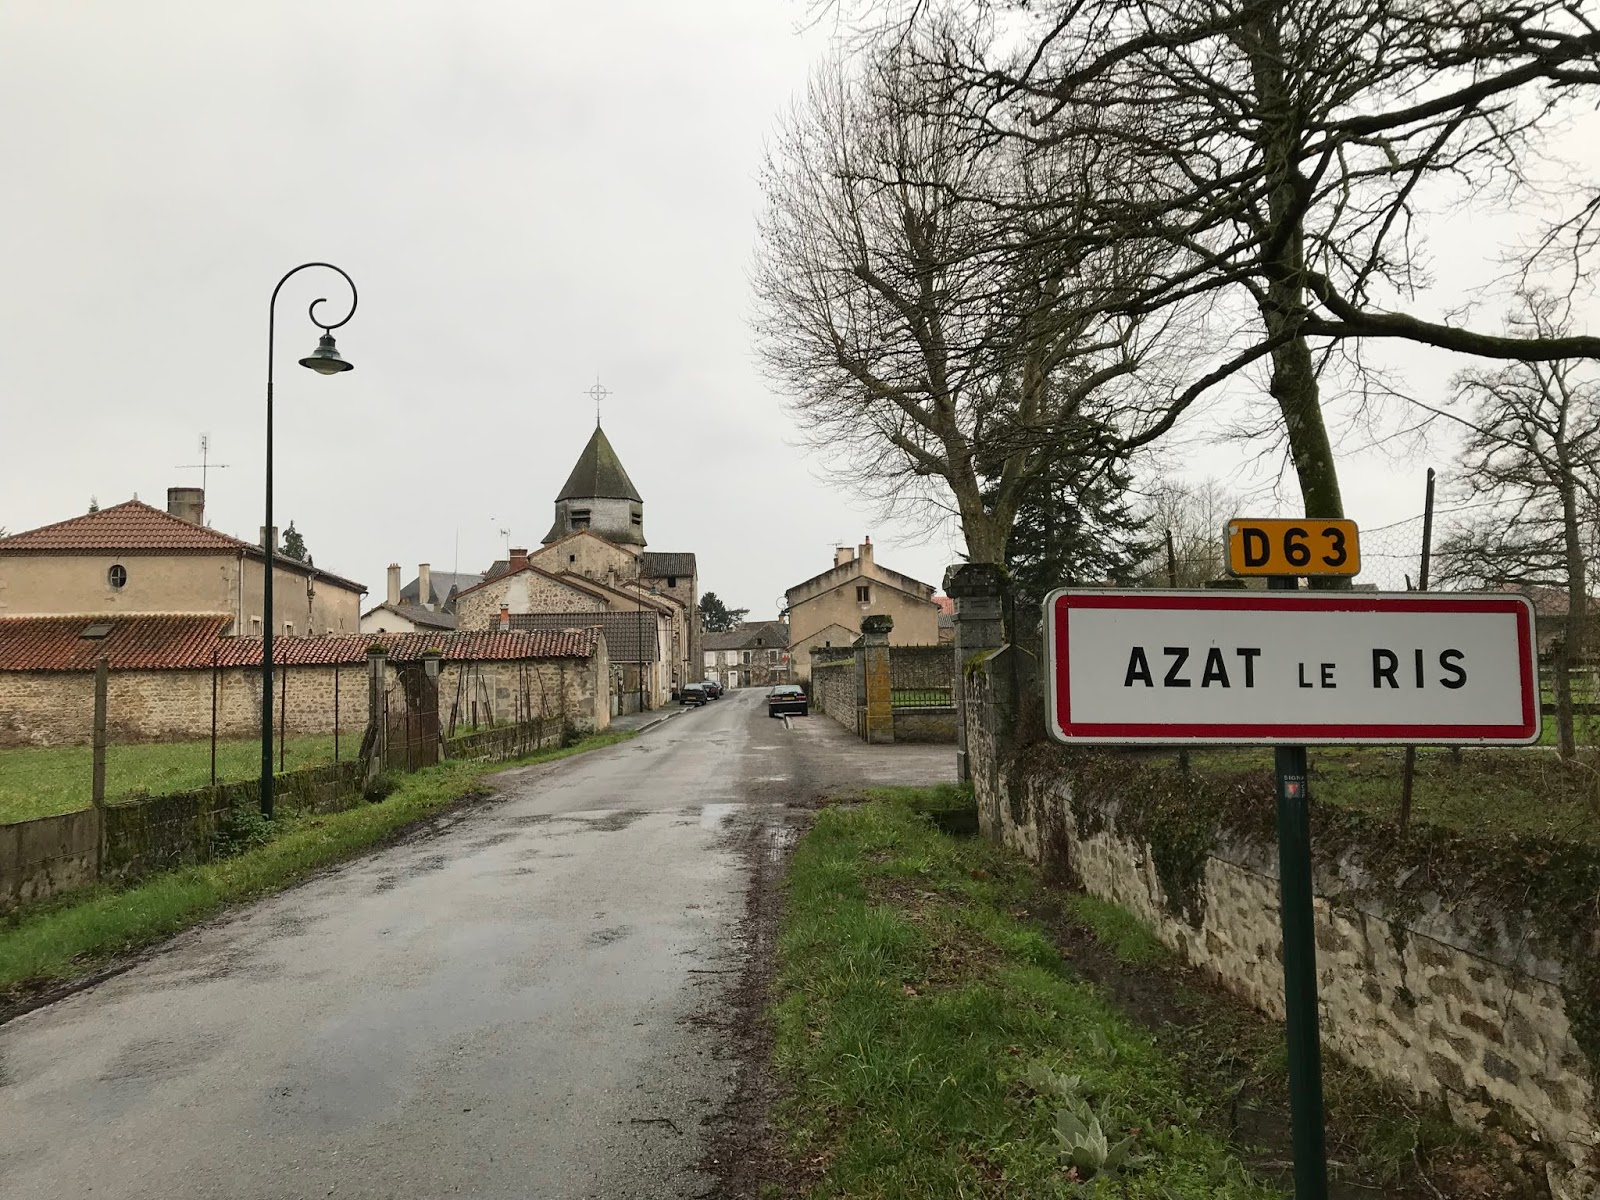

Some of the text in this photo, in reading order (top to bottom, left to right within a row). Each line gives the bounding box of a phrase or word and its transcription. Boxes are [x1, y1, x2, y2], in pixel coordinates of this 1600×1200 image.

[1123, 646, 1469, 690] AZAT LE RIS
